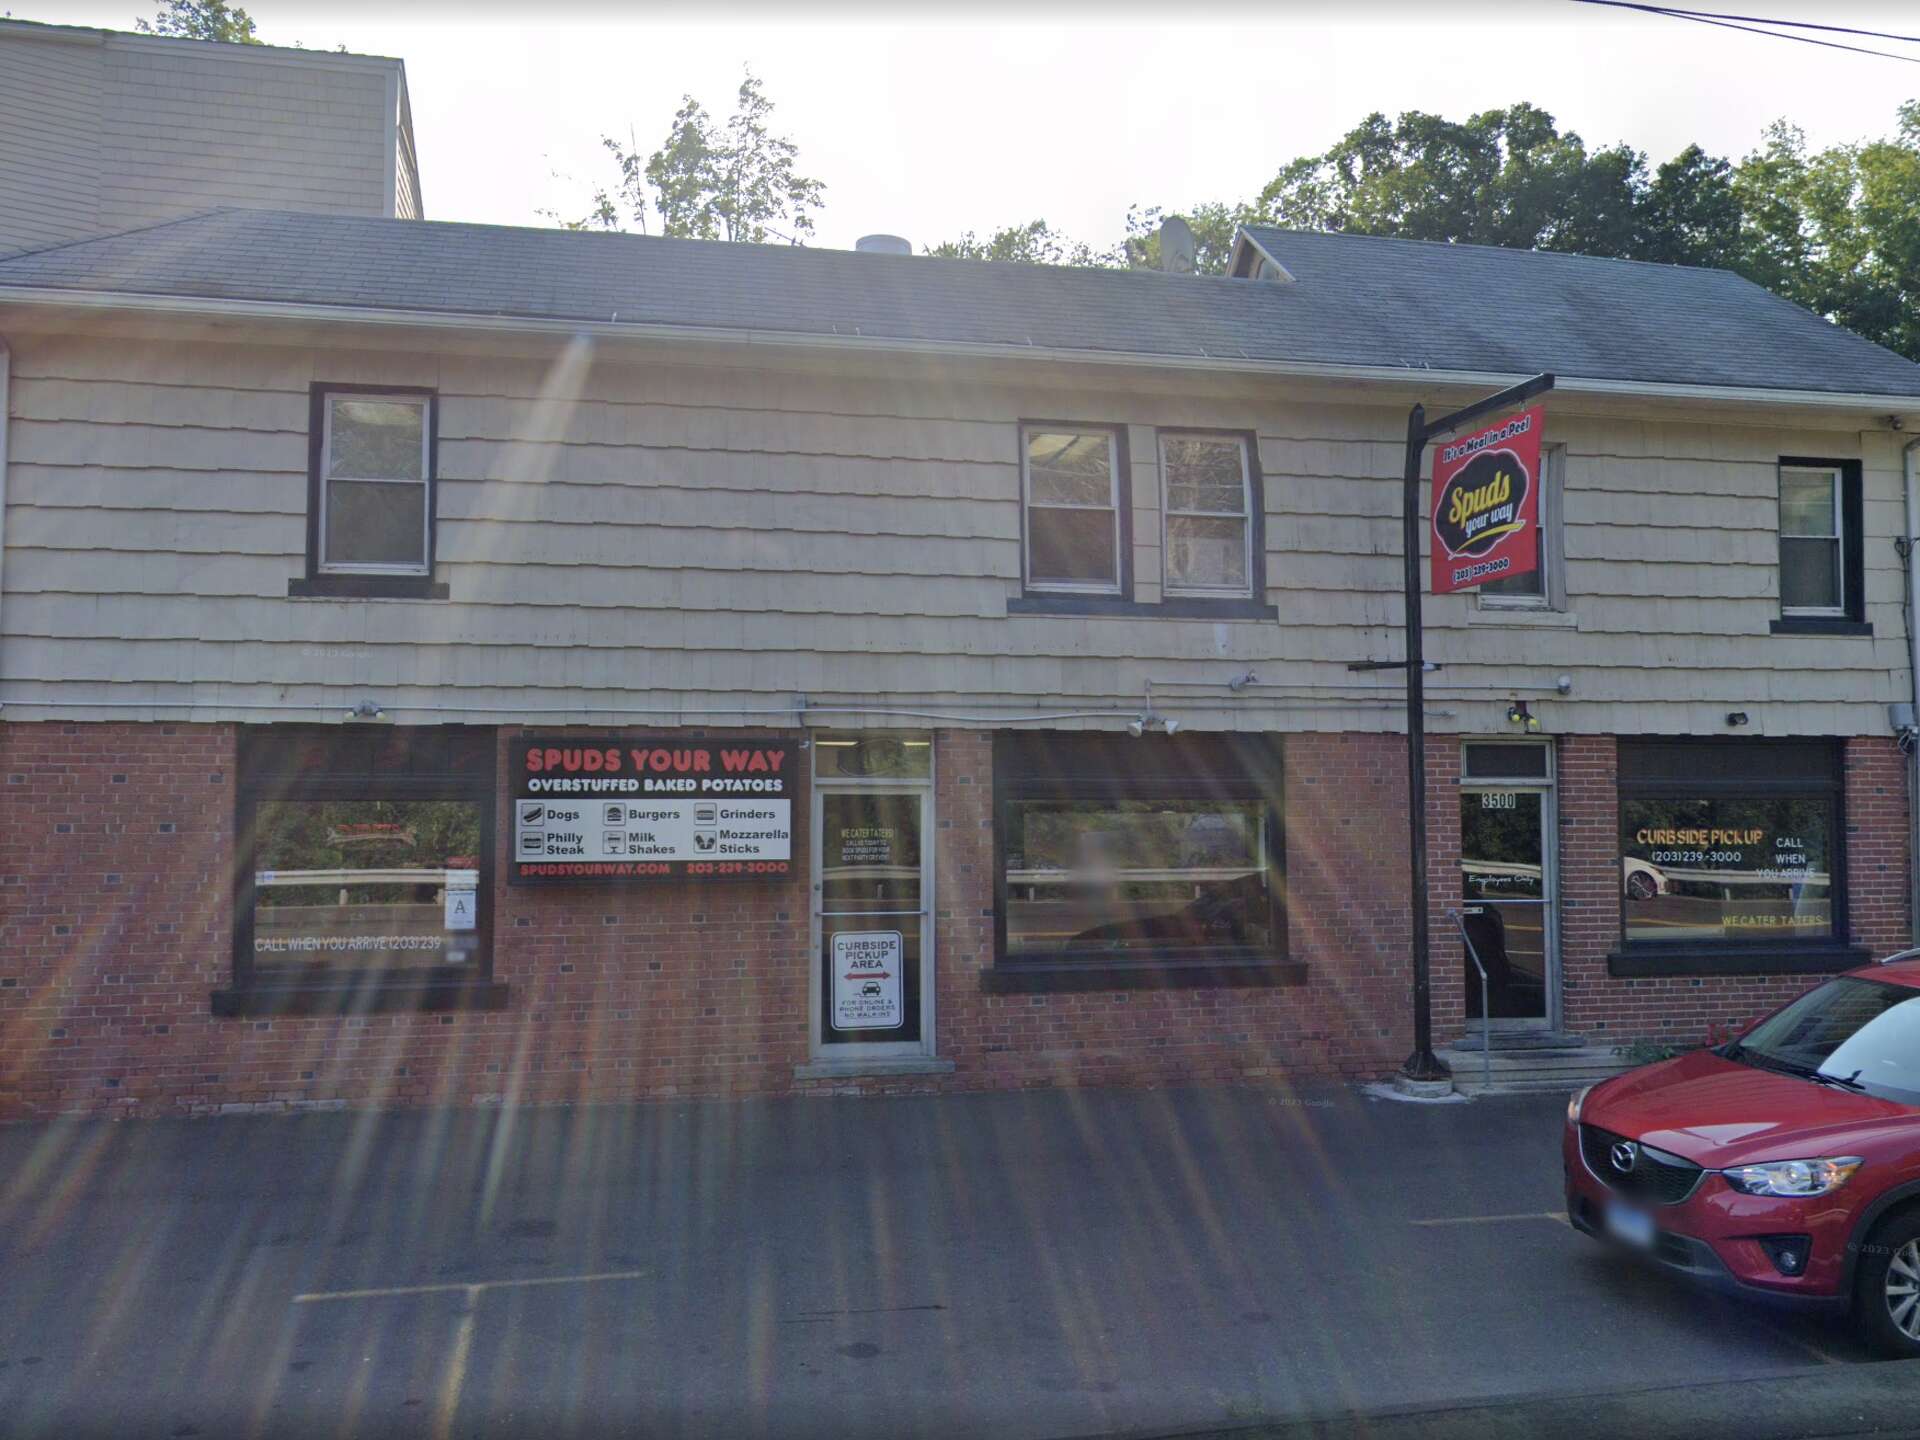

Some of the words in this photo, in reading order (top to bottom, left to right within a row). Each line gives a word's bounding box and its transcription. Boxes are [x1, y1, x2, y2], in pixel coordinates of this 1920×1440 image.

[1466, 433, 1487, 453] Meal
[1489, 430, 1498, 444] in
[1507, 415, 1531, 437] Peel
[1449, 470, 1510, 529] Spuds
[1465, 512, 1488, 538] your
[1490, 503, 1513, 523] way
[1453, 566, 1472, 584] (203)
[526, 748, 621, 772] SPUDS
[631, 749, 710, 772] YOUR
[720, 750, 785, 772] WAY
[528, 778, 639, 792] OVERSTUFFED
[644, 778, 696, 792] BAKED
[701, 778, 783, 791] POTATOES
[1483, 793, 1514, 808] 3500
[547, 809, 580, 821] Dogs
[629, 809, 680, 820] Burgers
[720, 809, 776, 819] Grinders
[547, 833, 583, 845] Philly
[629, 832, 656, 842] Milk
[719, 830, 789, 840] Mozzarella
[1637, 829, 1709, 844] CURBSIDE
[1776, 838, 1803, 848] CALL
[547, 845, 584, 855] Steak
[629, 844, 676, 854] Shakes
[719, 844, 760, 854] Sticks
[1775, 854, 1806, 864] WHEN
[520, 862, 671, 876] SPUDSYOURWAY.COM
[687, 862, 789, 873] 203-239-3000
[454, 898, 467, 913] A
[1722, 915, 1738, 926] WE
[1740, 915, 1776, 926] CATER
[254, 938, 286, 951] CALL
[288, 937, 320, 951] WHEN
[321, 937, 346, 950] YOU
[347, 936, 387, 950] ARRIVE
[837, 941, 896, 950] CURBSIDE
[845, 951, 888, 960] PICKUP
[851, 960, 883, 968] AREA
